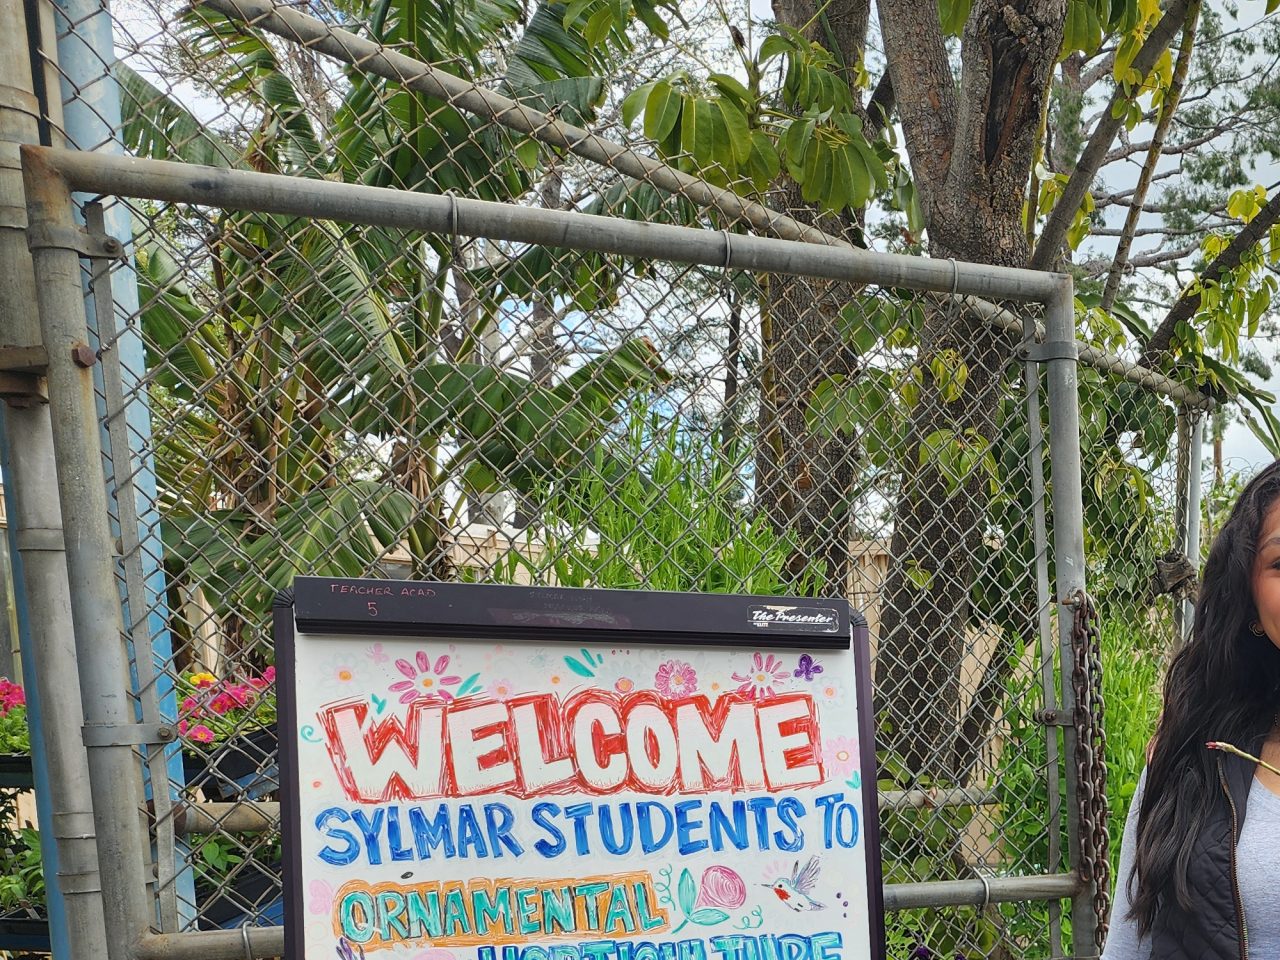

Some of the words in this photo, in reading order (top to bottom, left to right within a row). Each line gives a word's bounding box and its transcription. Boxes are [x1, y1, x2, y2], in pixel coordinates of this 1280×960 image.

[330, 584, 394, 596] TEACHER
[367, 601, 378, 616] 5
[752, 610, 775, 621] The
[775, 612, 833, 623] Presenter
[317, 689, 829, 802] WELCOME
[314, 804, 524, 866] SYLMAR
[531, 797, 806, 860] STUDENTS
[815, 792, 860, 850] TO
[336, 878, 668, 945] ORNAMENTAL
